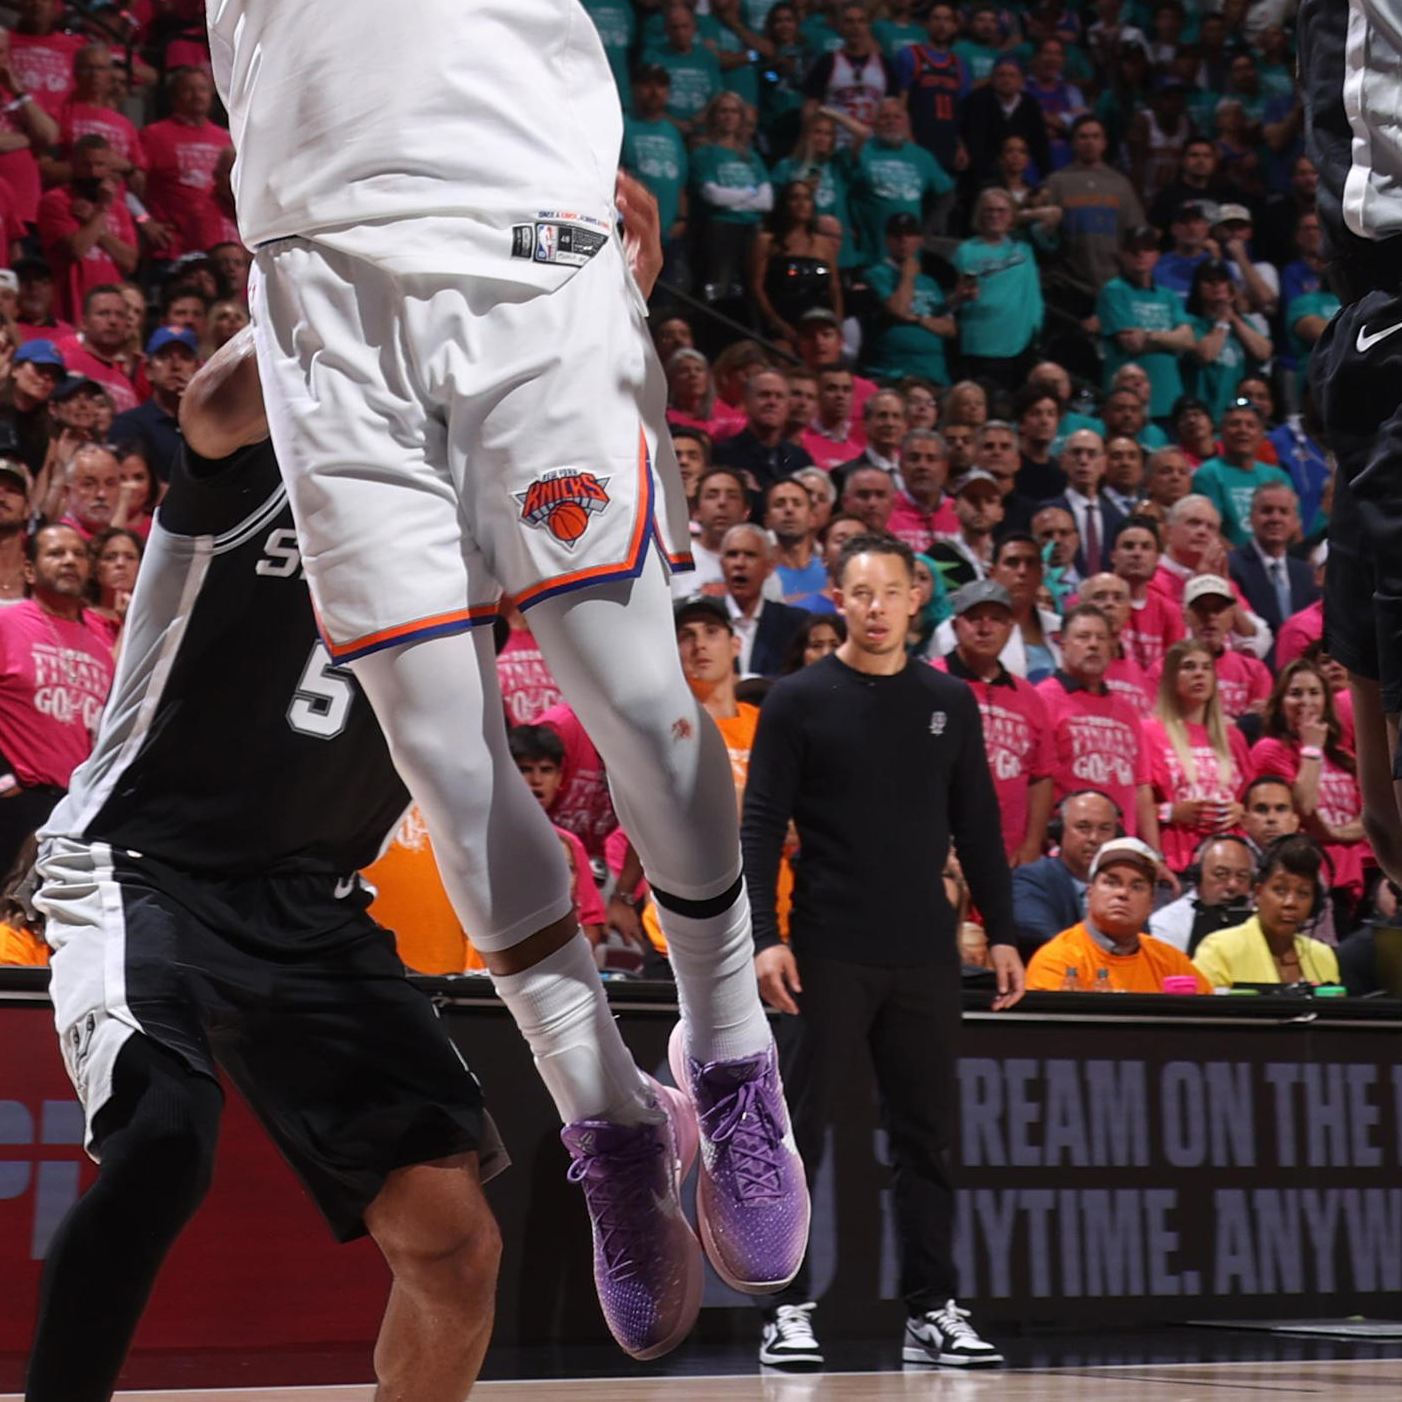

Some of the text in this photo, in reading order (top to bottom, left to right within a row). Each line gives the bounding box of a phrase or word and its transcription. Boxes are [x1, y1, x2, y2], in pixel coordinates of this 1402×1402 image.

[521, 472, 608, 521] KNICKS
[33, 687, 70, 724] GO
[286, 640, 354, 741] 5
[1160, 1061, 1257, 1168] ON
[1265, 1063, 1384, 1167] THE
